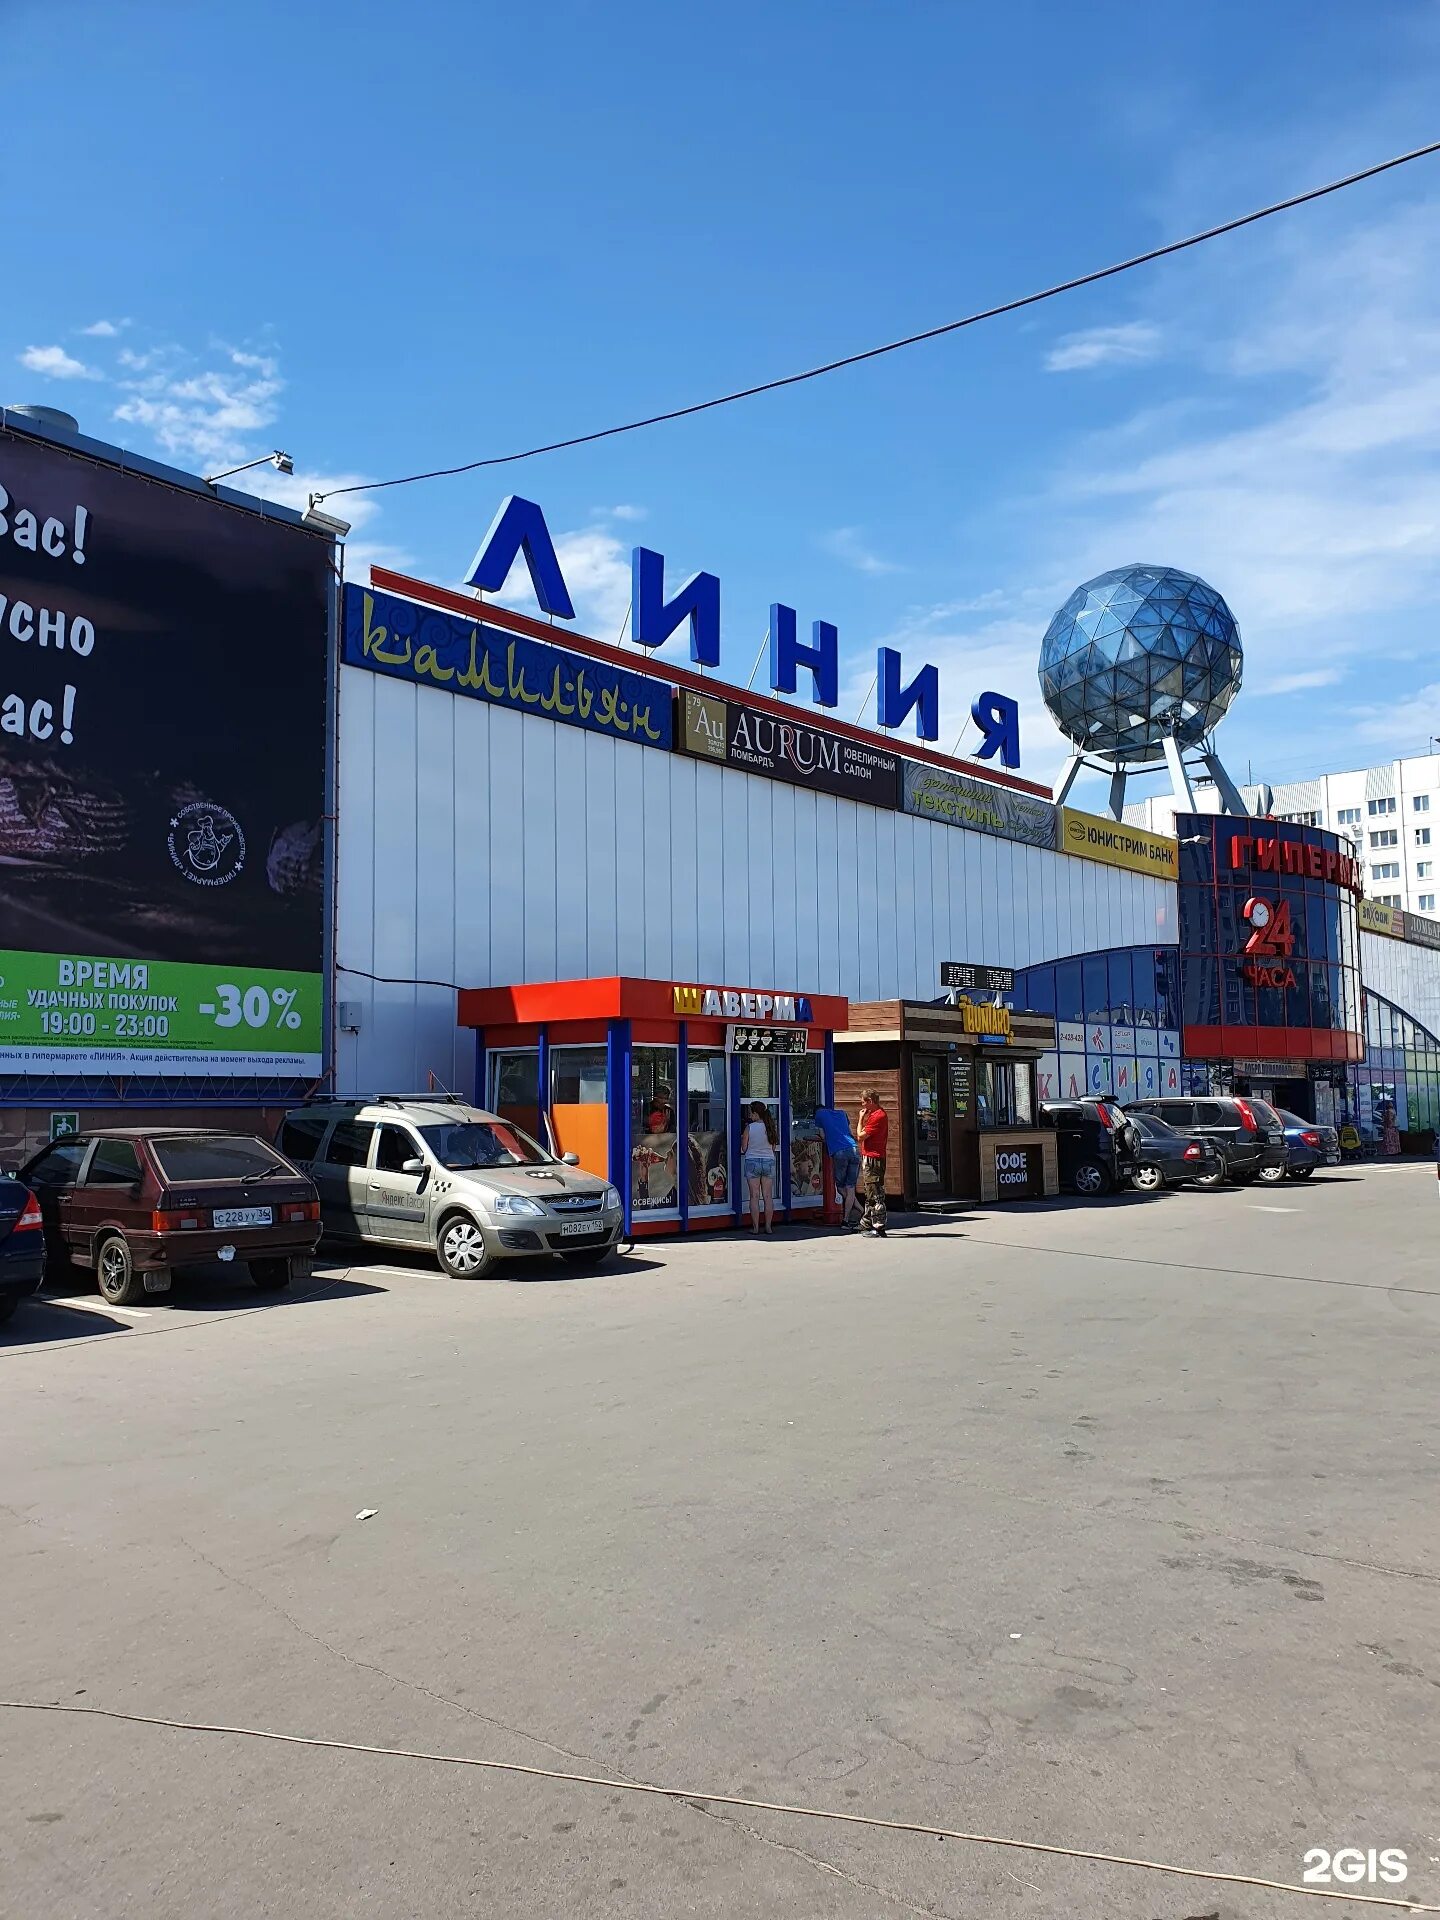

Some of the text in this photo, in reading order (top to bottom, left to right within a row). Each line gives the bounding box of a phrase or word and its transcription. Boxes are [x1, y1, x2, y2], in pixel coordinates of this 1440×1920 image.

[463, 494, 1021, 769] ЛИНИЯ
[0, 684, 77, 745] ас!
[693, 706, 725, 741] Au
[730, 712, 842, 775] AURUM
[730, 747, 775, 769] ЛОМБАРДЪ
[843, 746, 896, 772] ЮВЕЛИРНЫЙ
[843, 762, 872, 780] САЛОН
[177, 802, 223, 819] СОБСТВЕННОЕ
[1087, 826, 1175, 865] ЮНИСТРИМ БАНК
[1231, 835, 1362, 893] ГИПЕРМА
[182, 869, 237, 886] ГИПЕРМАРКЕТ
[1243, 897, 1296, 956] 24
[58, 959, 149, 991] ВРЕМЯ
[1246, 966, 1297, 988] ЧАСА
[27, 988, 179, 1013] УДАЧНЫХ ПОКУПОК
[199, 983, 302, 1031] -30%
[673, 986, 814, 1023] ШАВЕРМА
[41, 1011, 97, 1036] 19:00
[115, 1013, 170, 1038] 23:00
[25, 1052, 30, 1060] в
[32, 1052, 88, 1062] гипермаркете
[130, 1052, 153, 1062] Акция
[154, 1054, 209, 1064] действительна
[210, 1055, 219, 1063] на
[220, 1055, 246, 1063] момент
[247, 1056, 274, 1065] выхода
[1000, 1169, 1028, 1184] СОБОЙ
[381, 1190, 425, 1209] Яндекс Такси
[632, 1196, 672, 1207] ОСВЕЖИСЬ!
